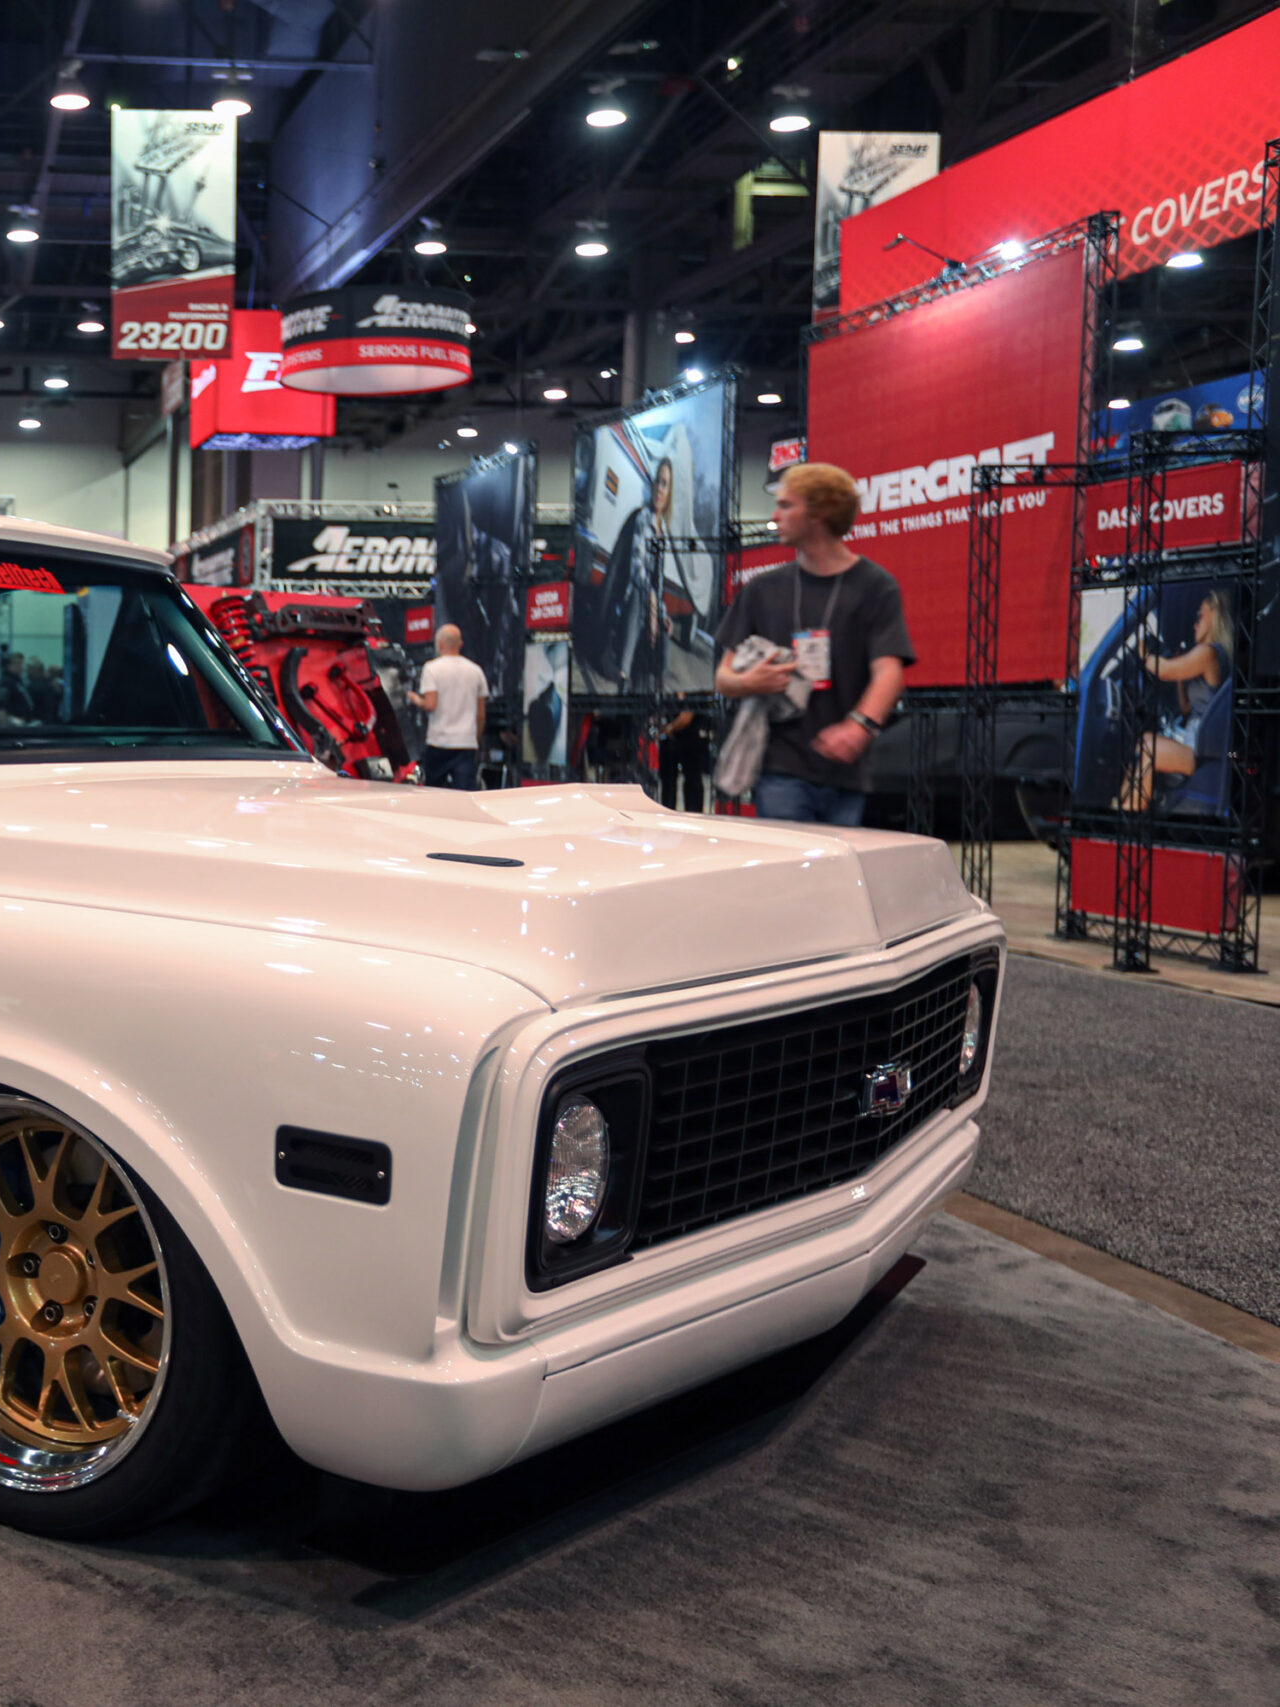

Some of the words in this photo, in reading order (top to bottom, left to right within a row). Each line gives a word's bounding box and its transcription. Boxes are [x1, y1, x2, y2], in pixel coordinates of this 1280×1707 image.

[1131, 158, 1271, 246] COVERS
[118, 321, 227, 350] 23200
[359, 344, 418, 358] SERIOUS
[853, 431, 1055, 514] VERCRAFT
[1017, 490, 1046, 511] YOU
[1148, 493, 1224, 523] COVERS
